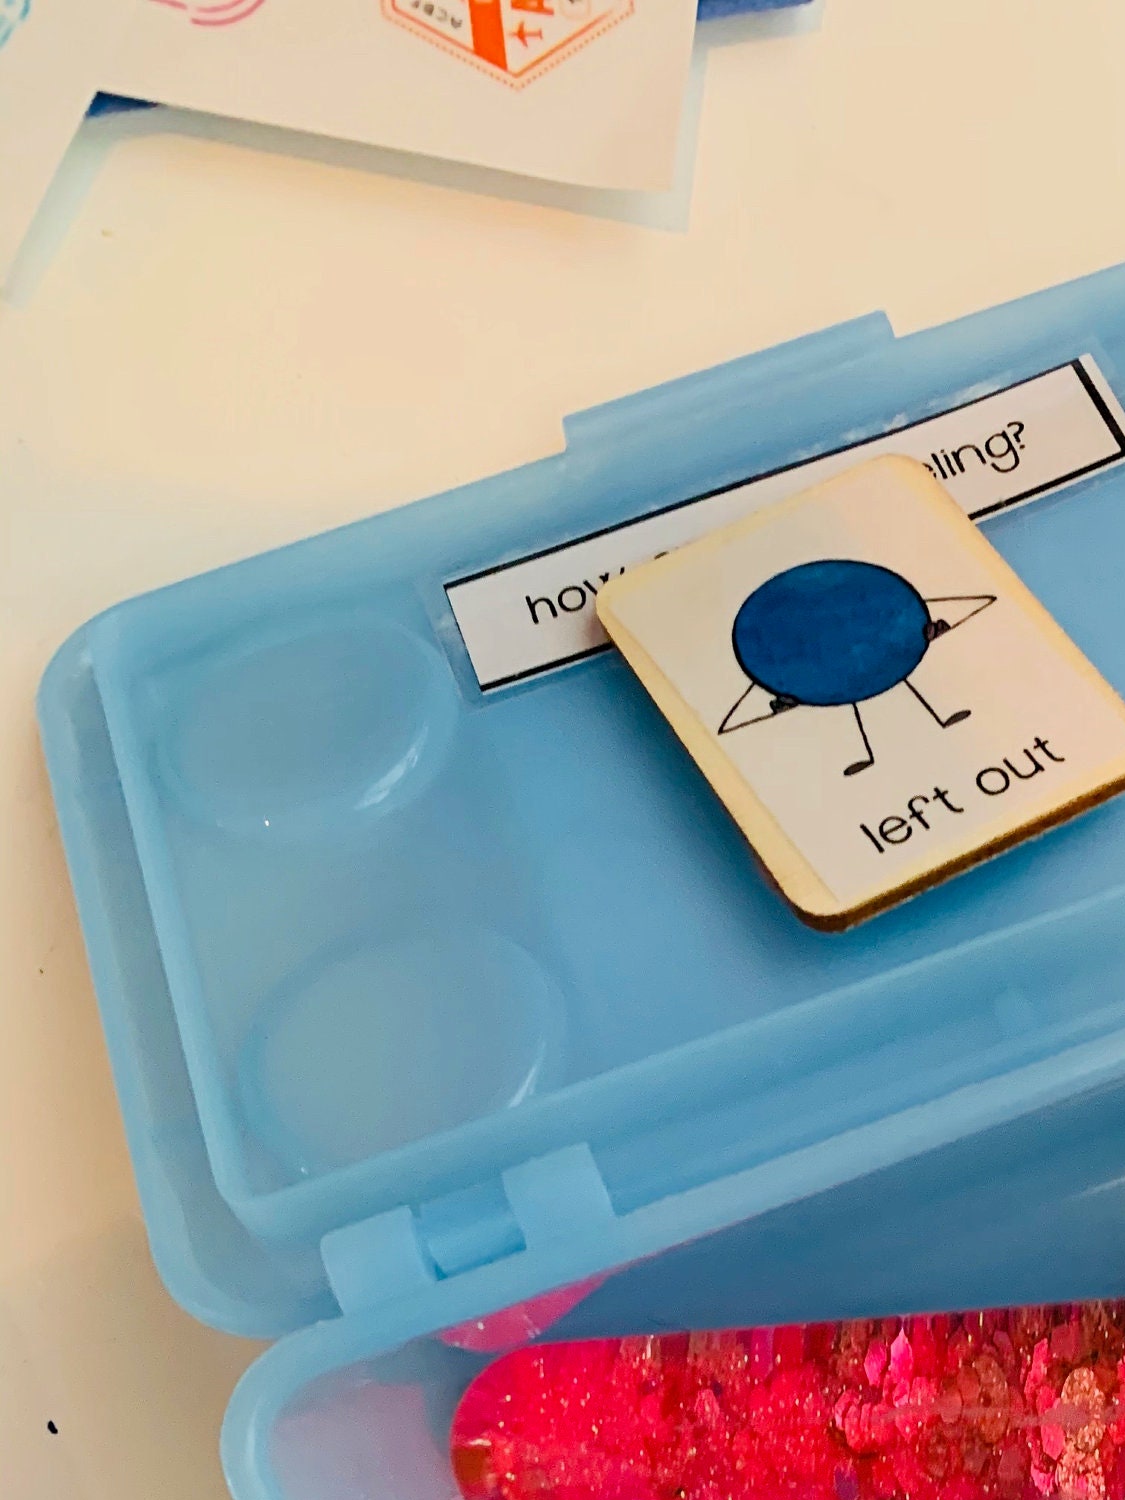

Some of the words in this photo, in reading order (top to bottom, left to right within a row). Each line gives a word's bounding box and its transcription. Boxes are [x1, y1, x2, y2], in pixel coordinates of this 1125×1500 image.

[922, 421, 1025, 480] ling?
[859, 786, 964, 854] left
[975, 736, 1065, 796] out
